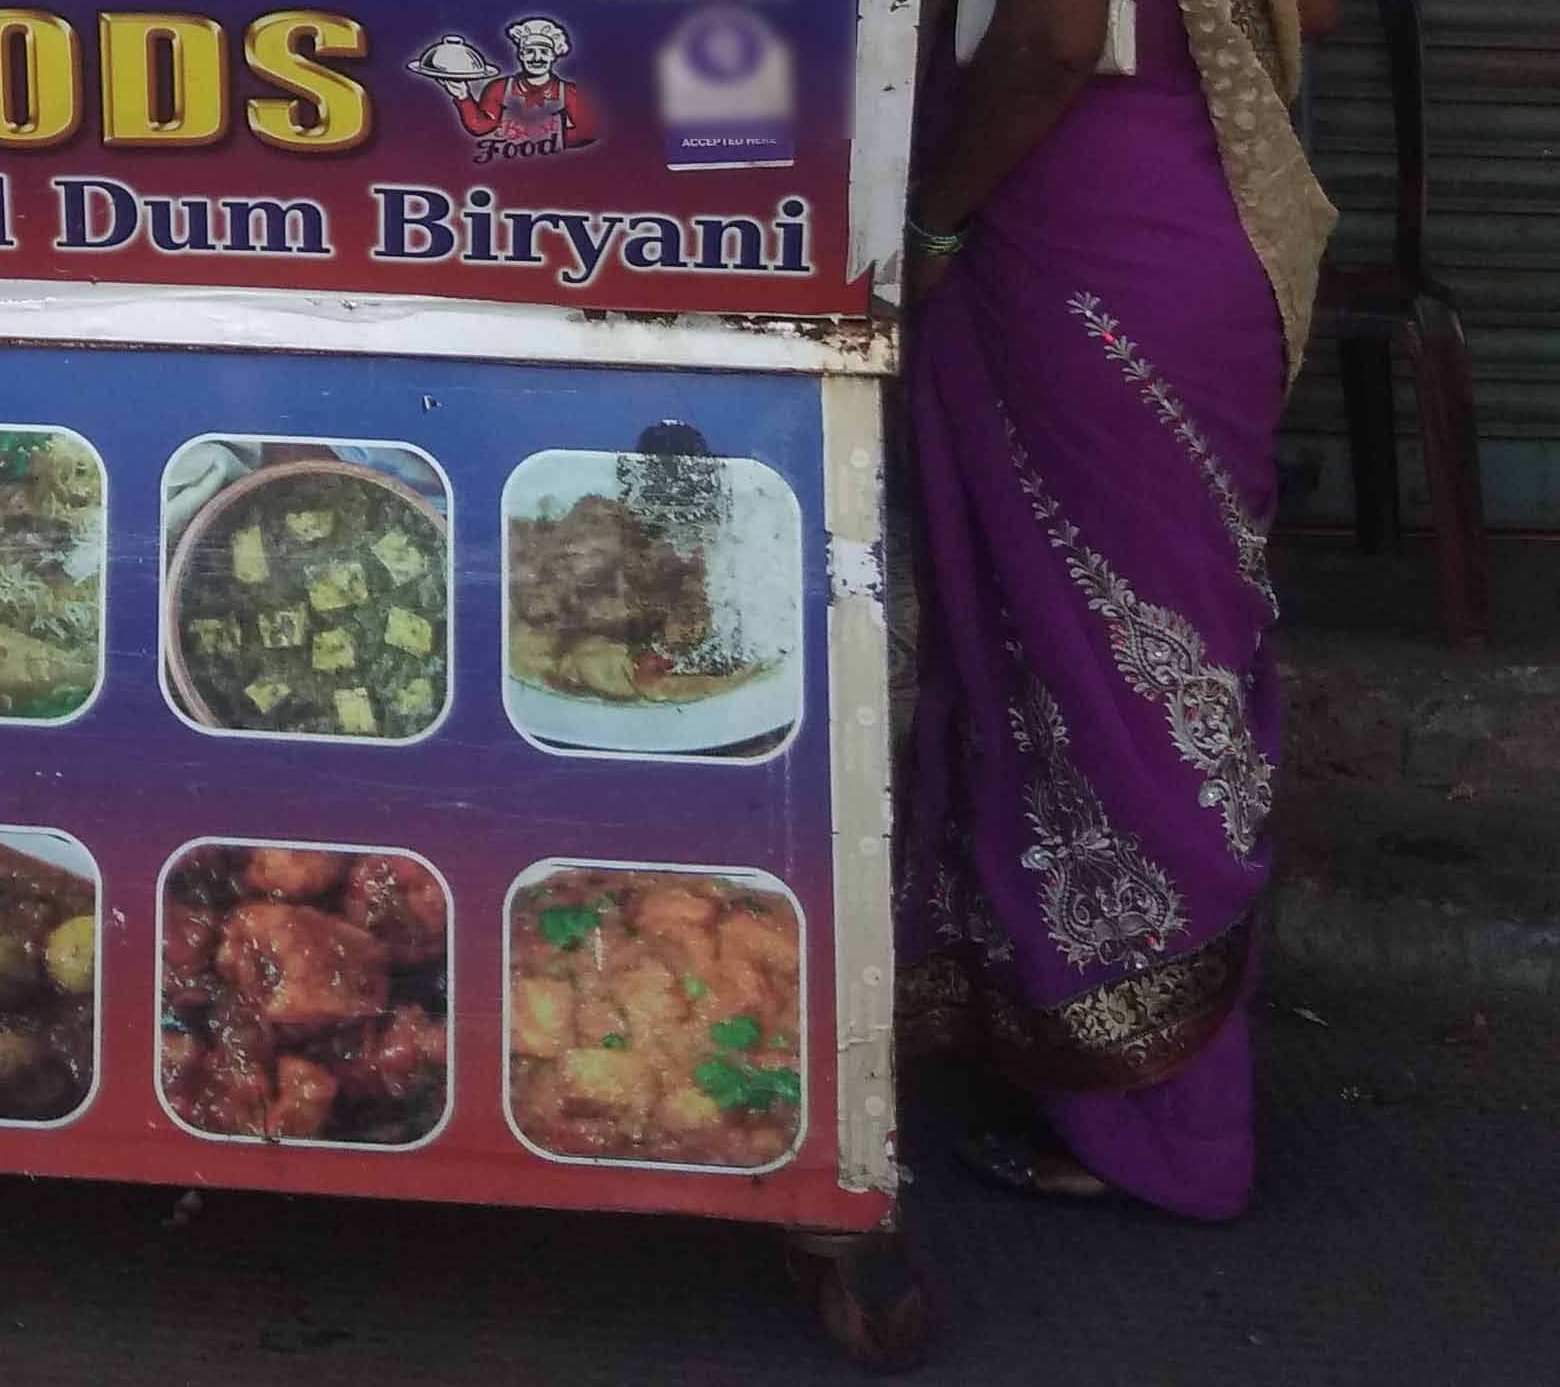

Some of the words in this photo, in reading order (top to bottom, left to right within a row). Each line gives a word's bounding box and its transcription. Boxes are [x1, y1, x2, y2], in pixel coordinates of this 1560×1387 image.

[472, 132, 561, 165] Food
[54, 173, 330, 257] Dum
[372, 182, 813, 284] Biryani
